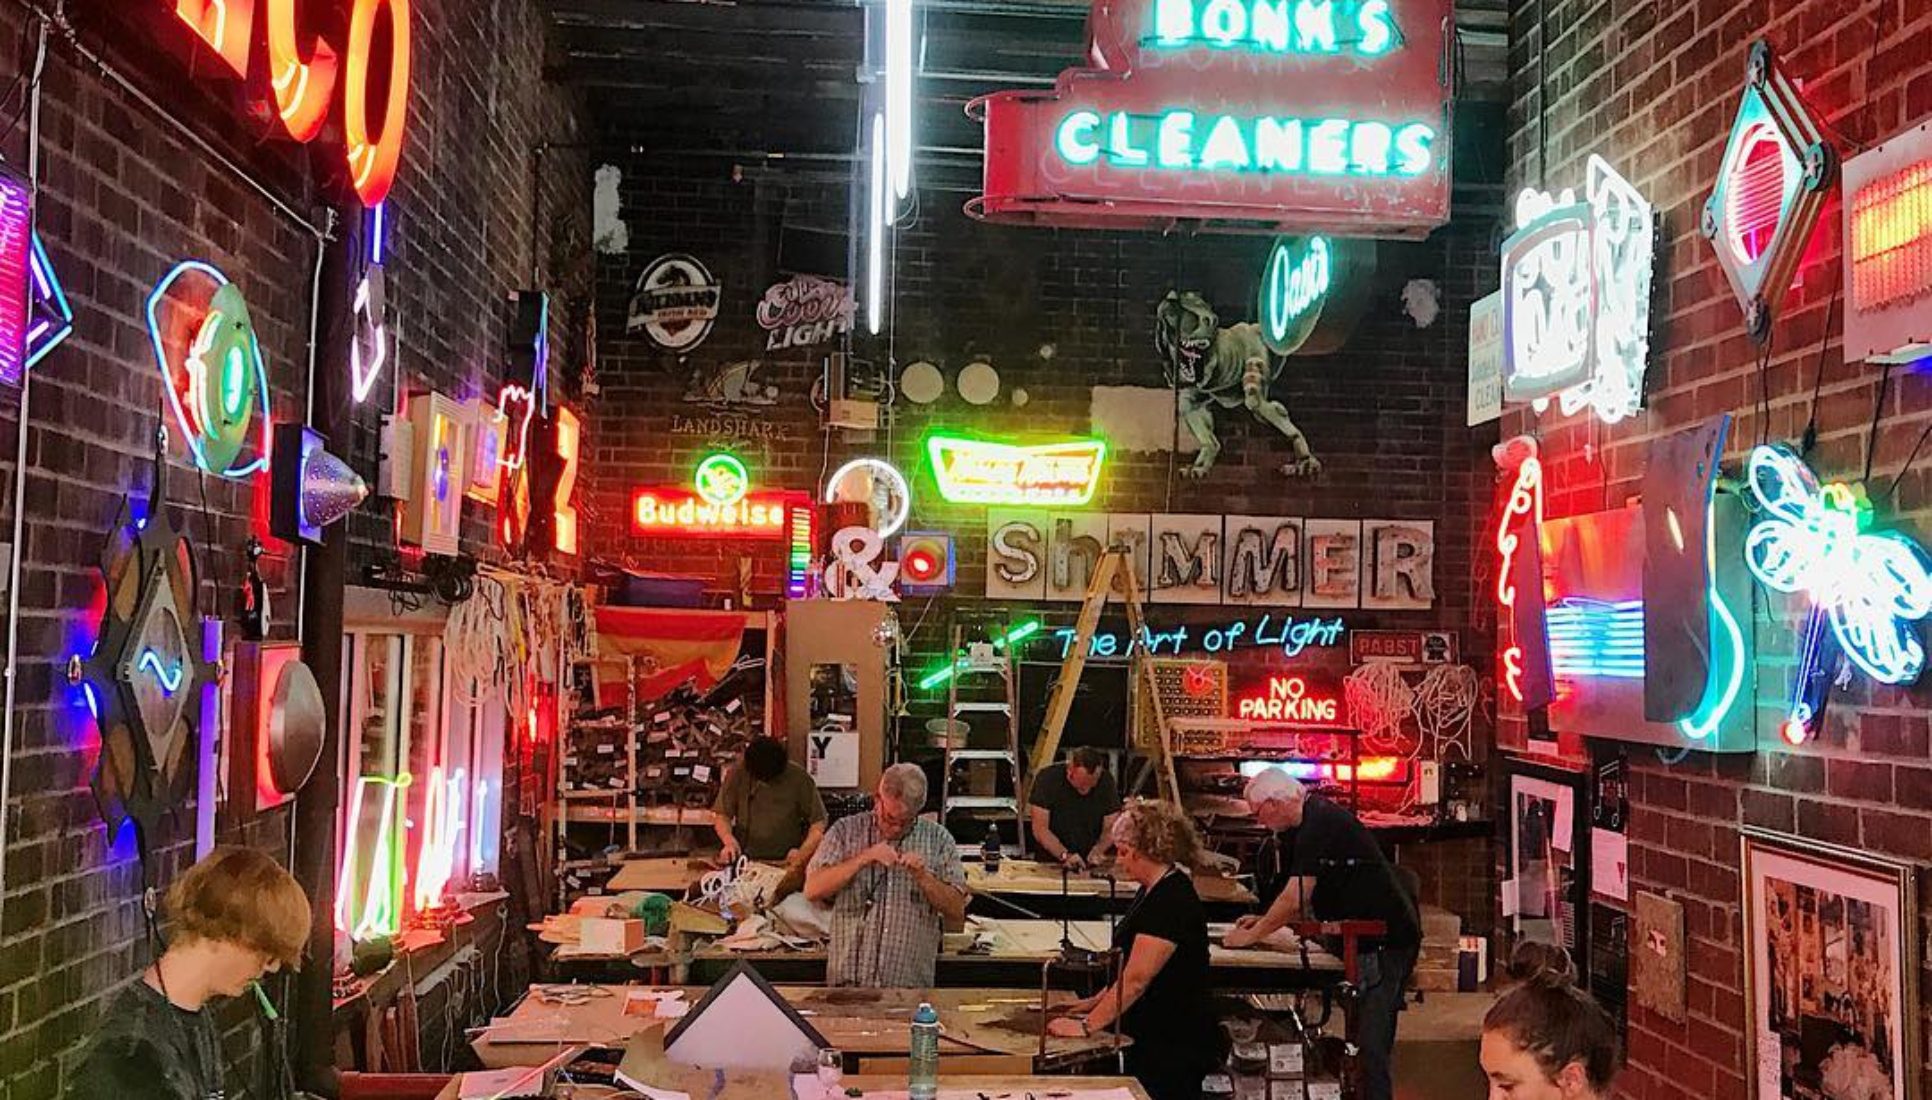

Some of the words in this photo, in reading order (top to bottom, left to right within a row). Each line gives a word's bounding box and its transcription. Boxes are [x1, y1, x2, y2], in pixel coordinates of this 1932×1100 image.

[1056, 110, 1435, 177] CLEANERS
[765, 317, 848, 351] LIGHT
[671, 414, 789, 442] LANDSHARK
[638, 496, 785, 526] Budweise
[1124, 625, 1188, 657] Art
[1203, 621, 1245, 652] of
[1255, 614, 1344, 657] Light
[1357, 638, 1419, 655] PABST
[1270, 677, 1305, 700] NO
[1240, 697, 1337, 721] PARKING
[811, 736, 832, 759] Y
